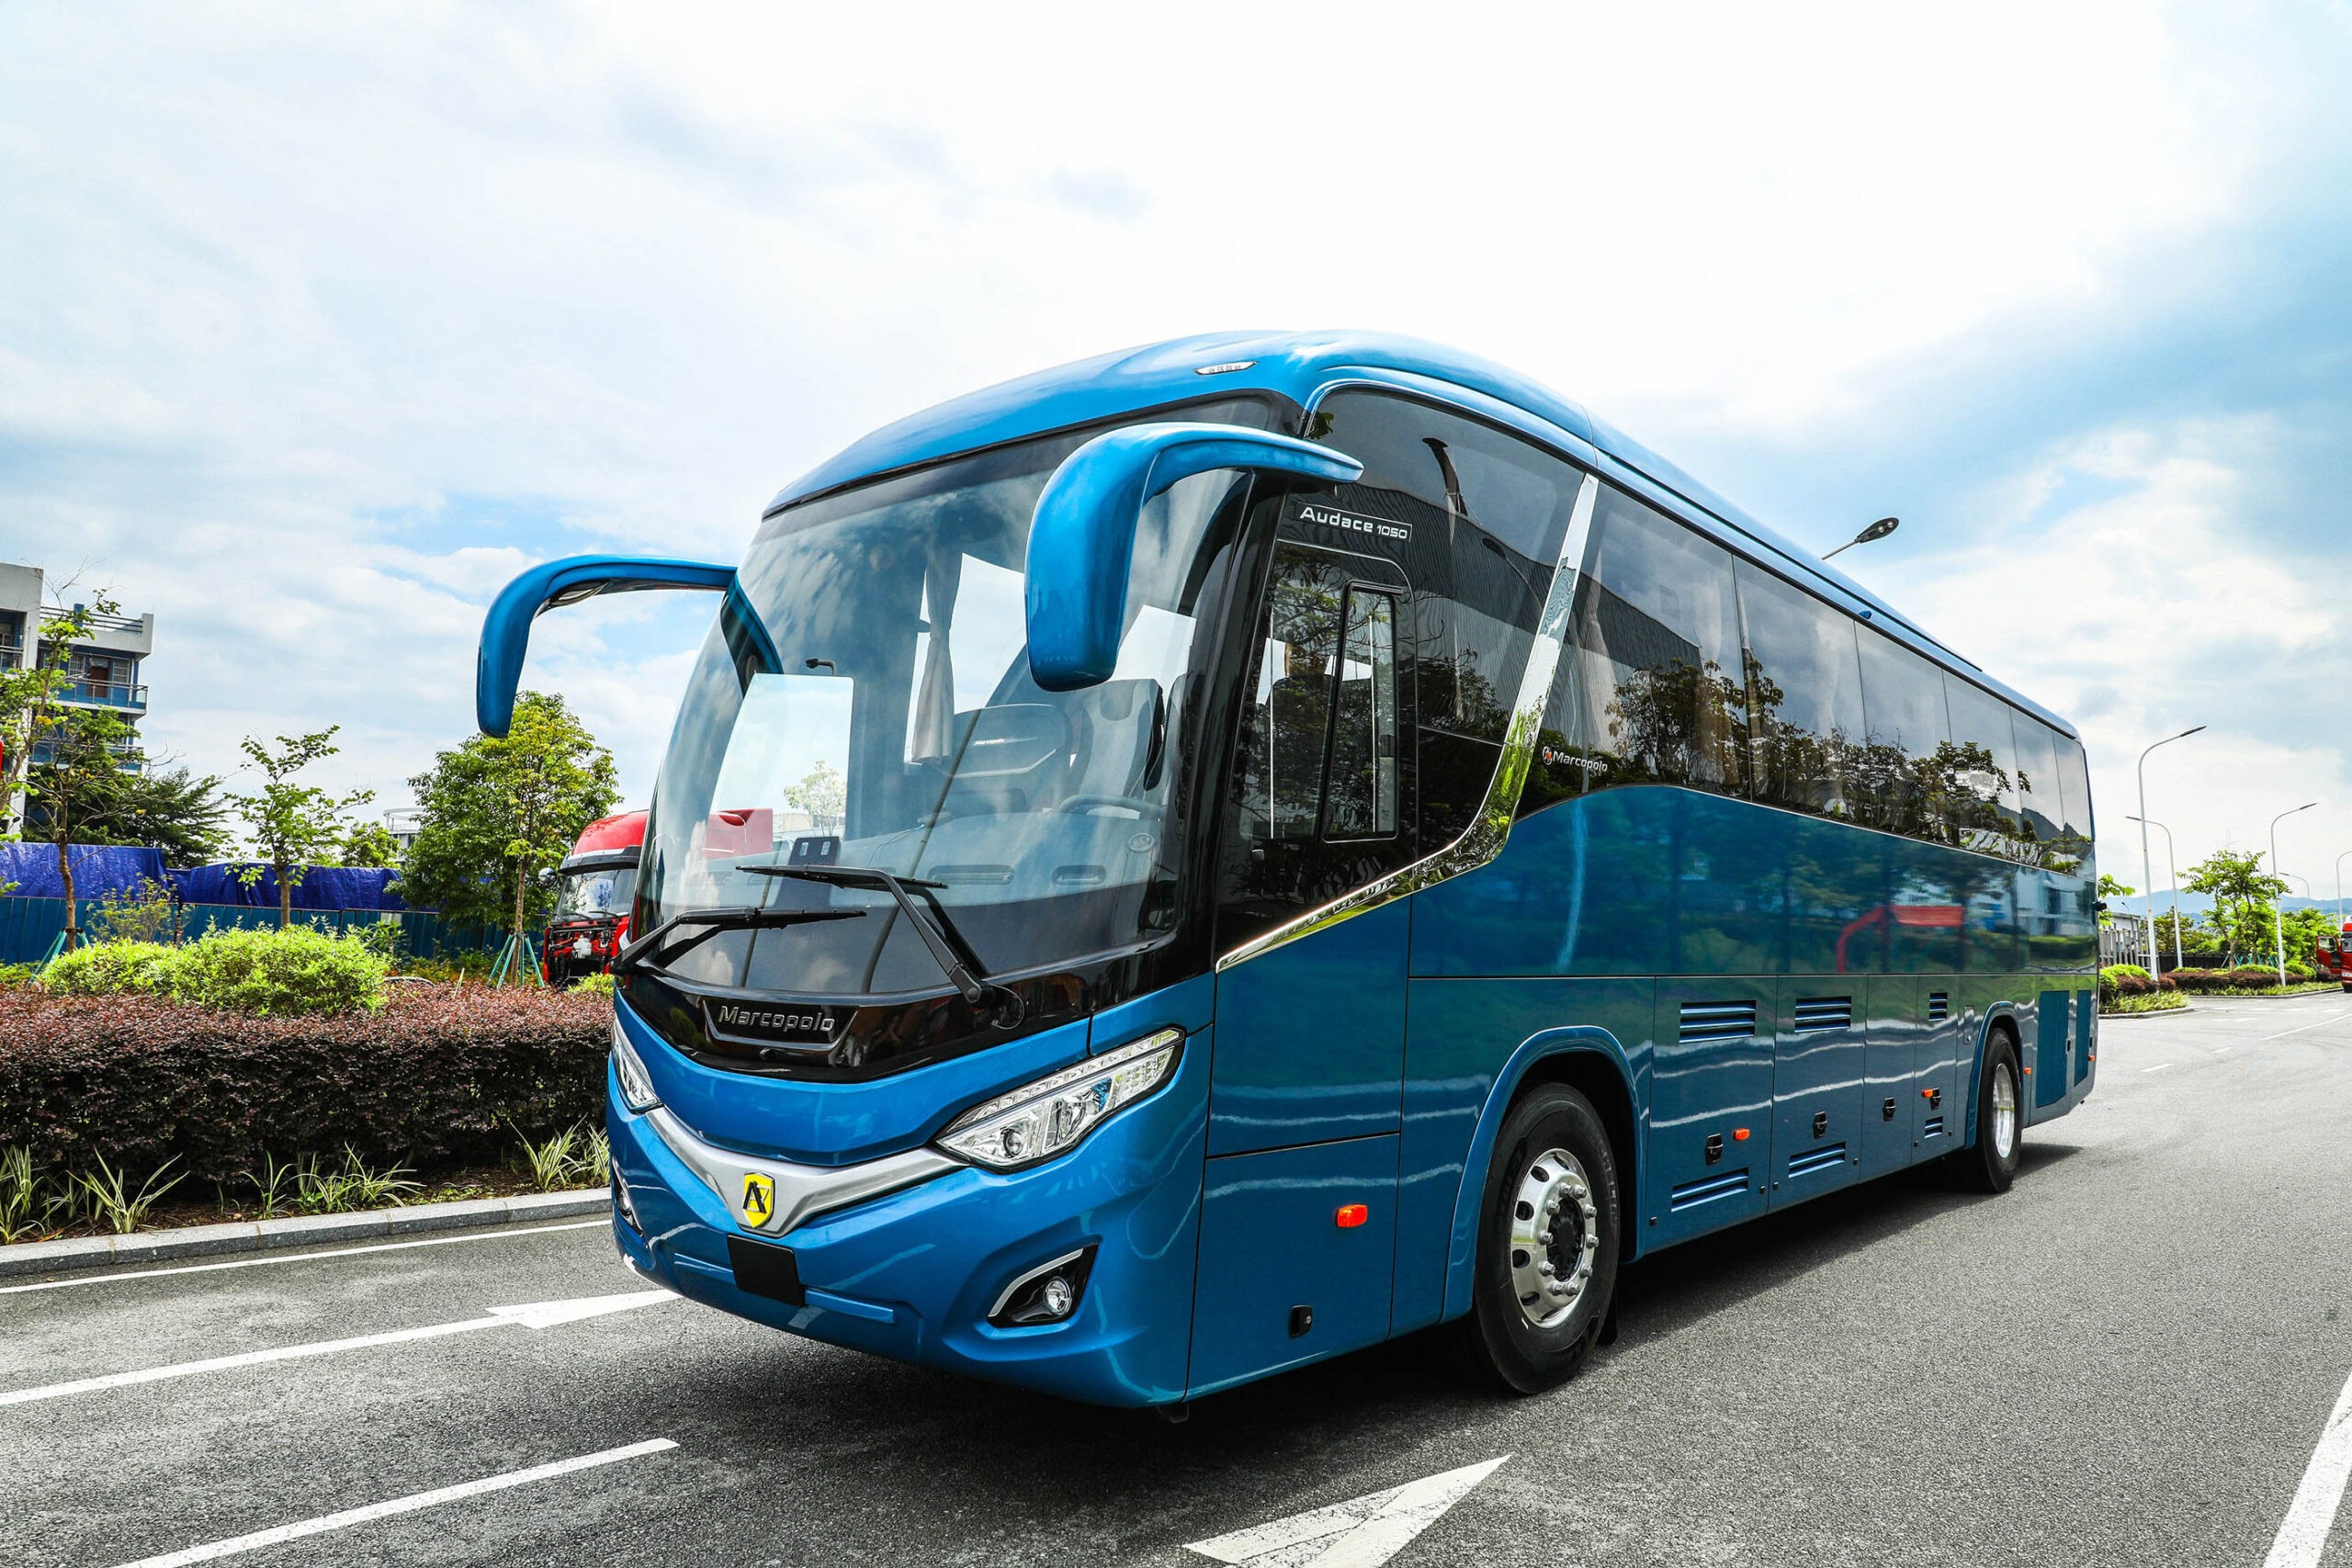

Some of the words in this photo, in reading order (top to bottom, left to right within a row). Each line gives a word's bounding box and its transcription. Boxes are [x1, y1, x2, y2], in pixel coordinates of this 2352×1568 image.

[1300, 506, 1374, 533] Audace
[1376, 525, 1408, 539] 1050
[1553, 750, 1608, 772] Marcopolo
[718, 1005, 835, 1032] Marcopolo
